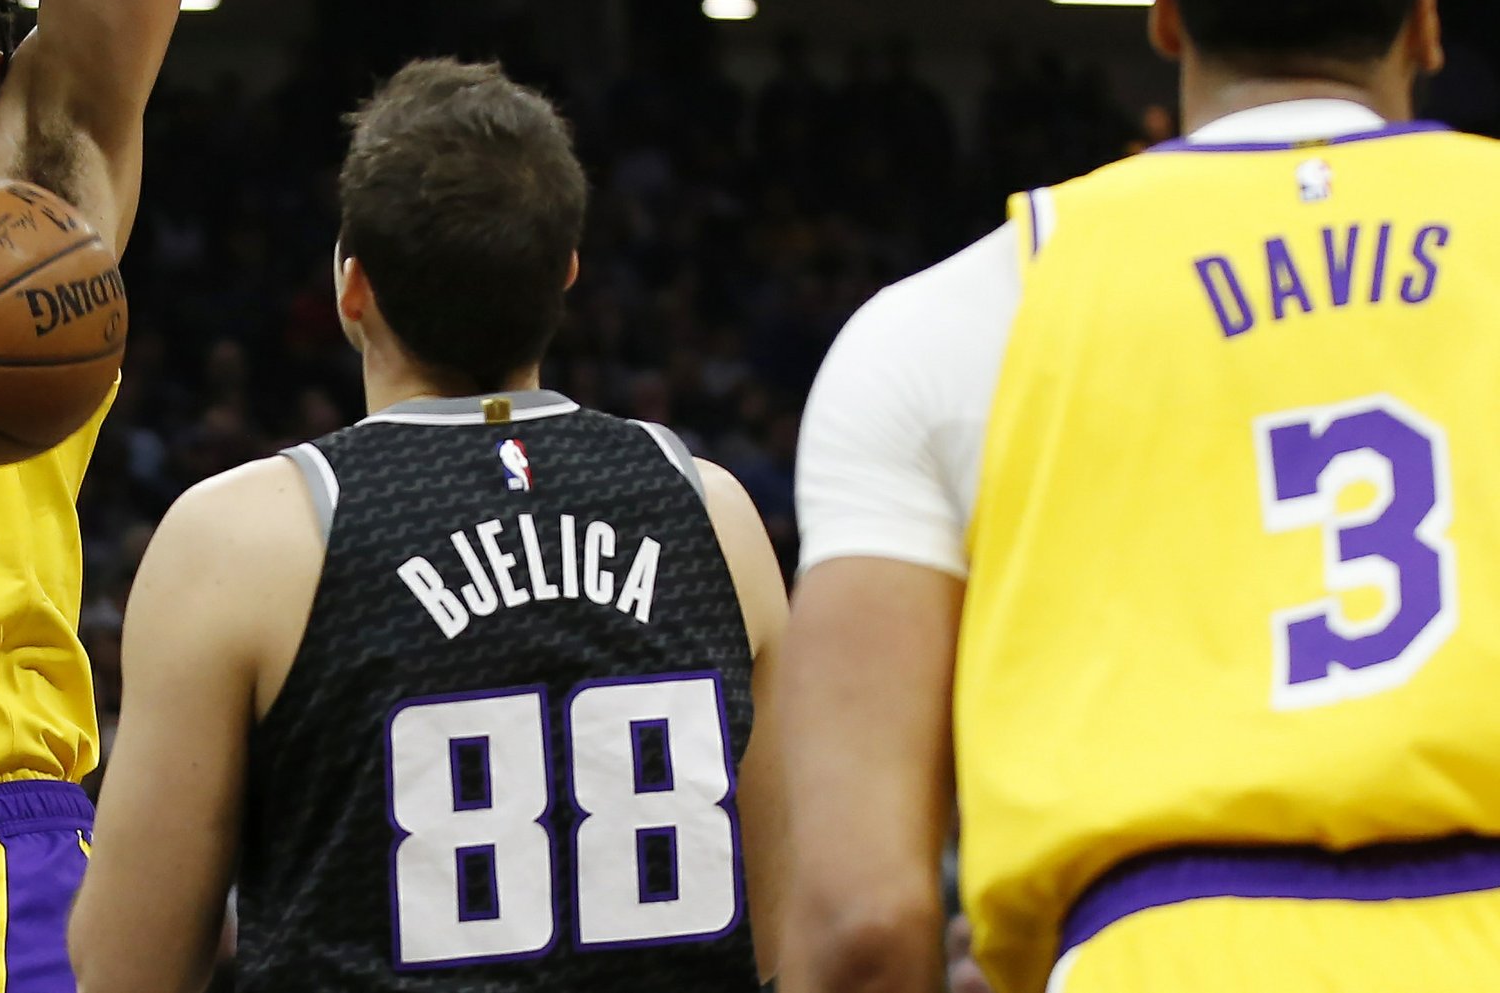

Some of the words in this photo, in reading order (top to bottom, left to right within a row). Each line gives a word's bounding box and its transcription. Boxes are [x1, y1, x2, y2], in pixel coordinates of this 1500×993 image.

[1194, 223, 1451, 339] DAVIS
[396, 512, 662, 640] BJELICA
[1252, 393, 1458, 712] 3
[386, 669, 742, 970] 88
